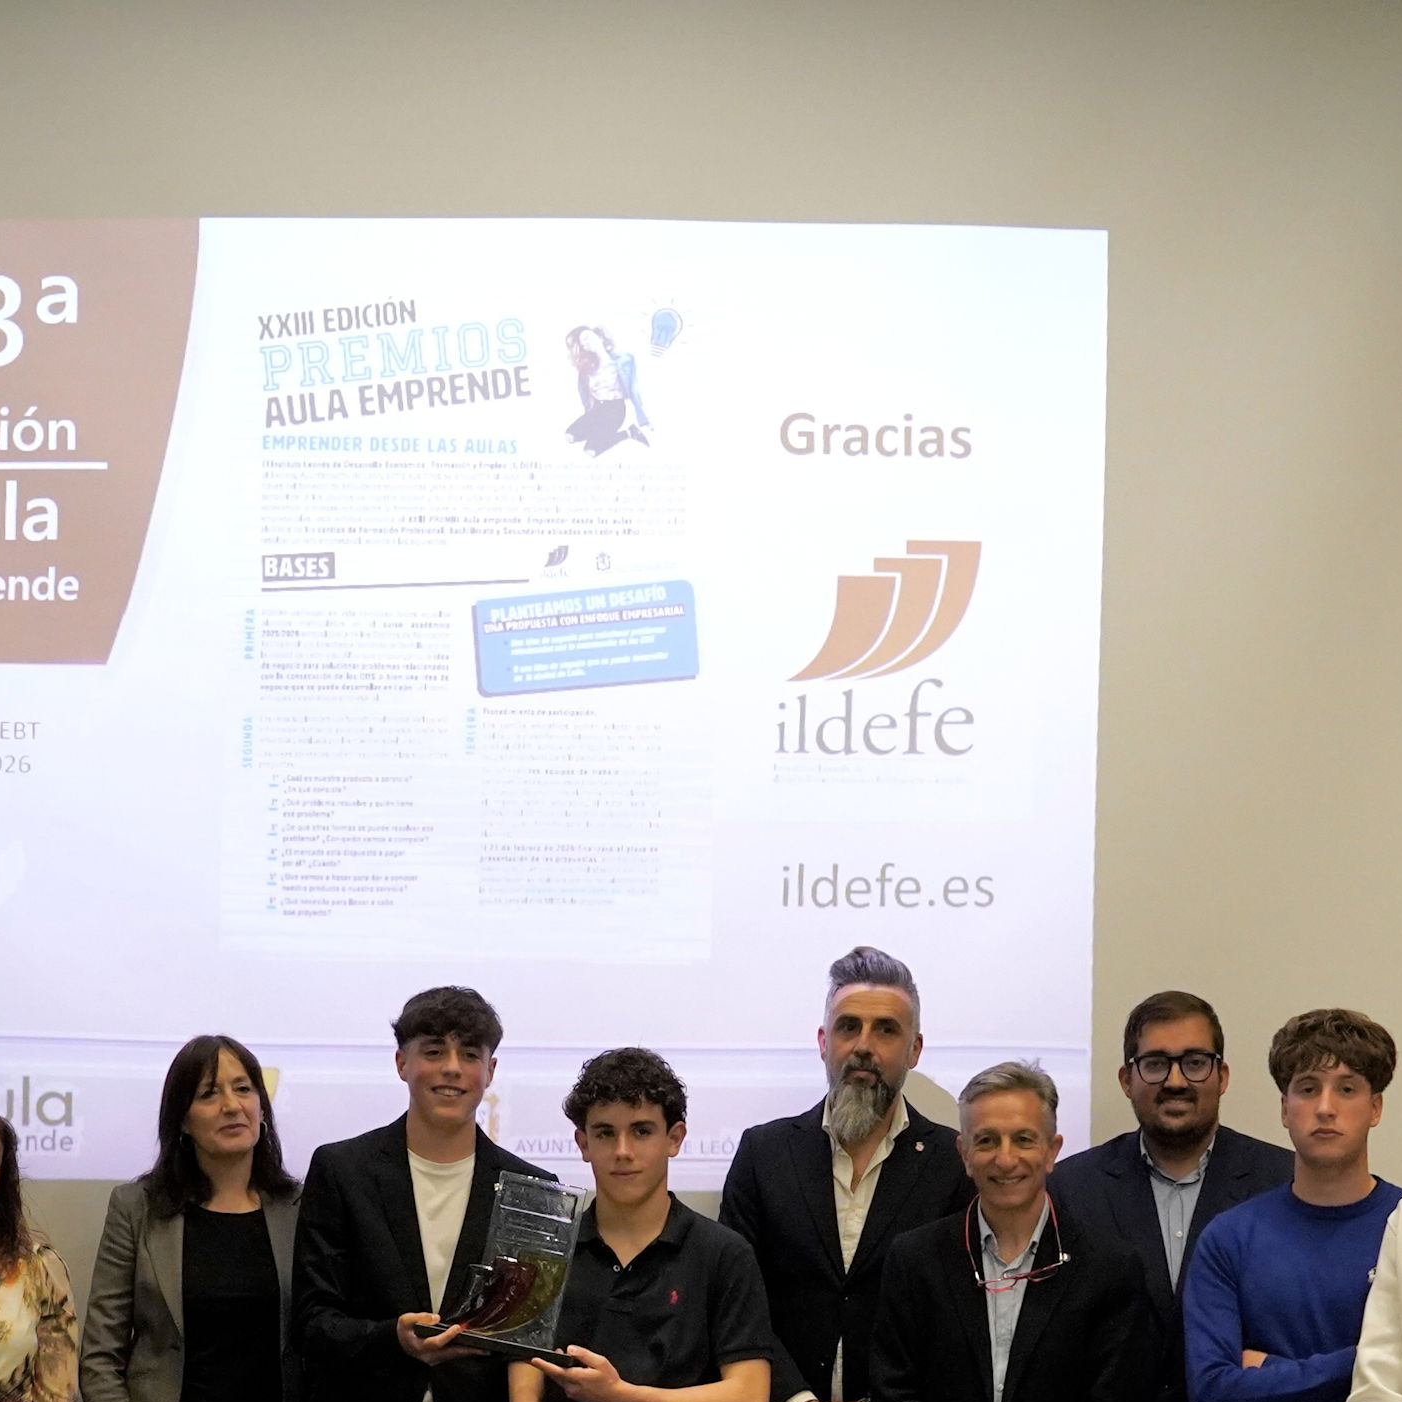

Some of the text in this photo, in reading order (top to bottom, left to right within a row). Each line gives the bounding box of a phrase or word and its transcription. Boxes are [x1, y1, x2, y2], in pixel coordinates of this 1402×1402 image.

[258, 296, 417, 341] XXIII EDICIÓN
[259, 317, 527, 391] PREMIOS
[264, 364, 532, 428] AULA EMPRENDE
[262, 434, 518, 455] EMPRENDER DESDE LAS AULAS
[779, 411, 973, 459] Gracias
[264, 556, 329, 577] BASES
[483, 605, 685, 634] UNA PROPUESTA CON ENFOQUE EMPRESARIAL
[490, 585, 667, 622] PLANTEAMOS UN DESAFÍO
[774, 678, 975, 757] ildefe
[242, 716, 253, 769] SEGUNDA
[782, 863, 996, 909] ildefe.es
[699, 1131, 737, 1156] LEÓ
